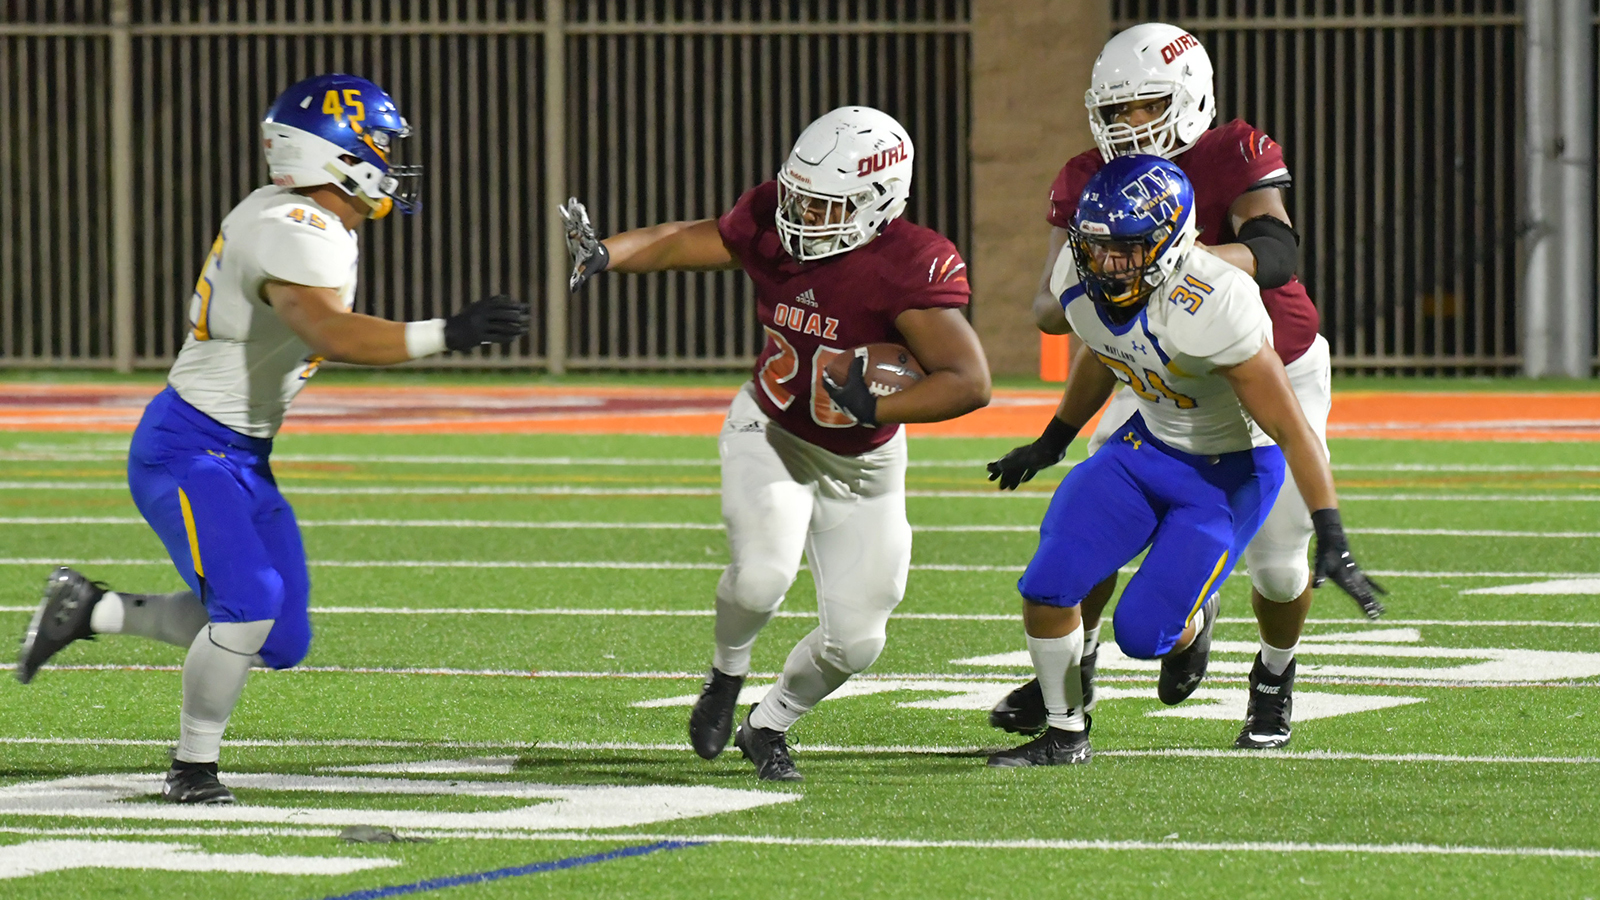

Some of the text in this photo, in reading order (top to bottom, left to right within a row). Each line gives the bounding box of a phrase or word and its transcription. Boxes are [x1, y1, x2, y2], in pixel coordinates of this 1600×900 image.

[1160, 33, 1198, 65] OUAZ
[322, 89, 365, 121] 45
[857, 141, 907, 177] OUAZ
[286, 208, 326, 231] 45
[1168, 273, 1215, 316] 31
[774, 303, 839, 340] OUAZ
[1103, 343, 1136, 363] WAYLAND
[1256, 682, 1281, 695] NIKE
